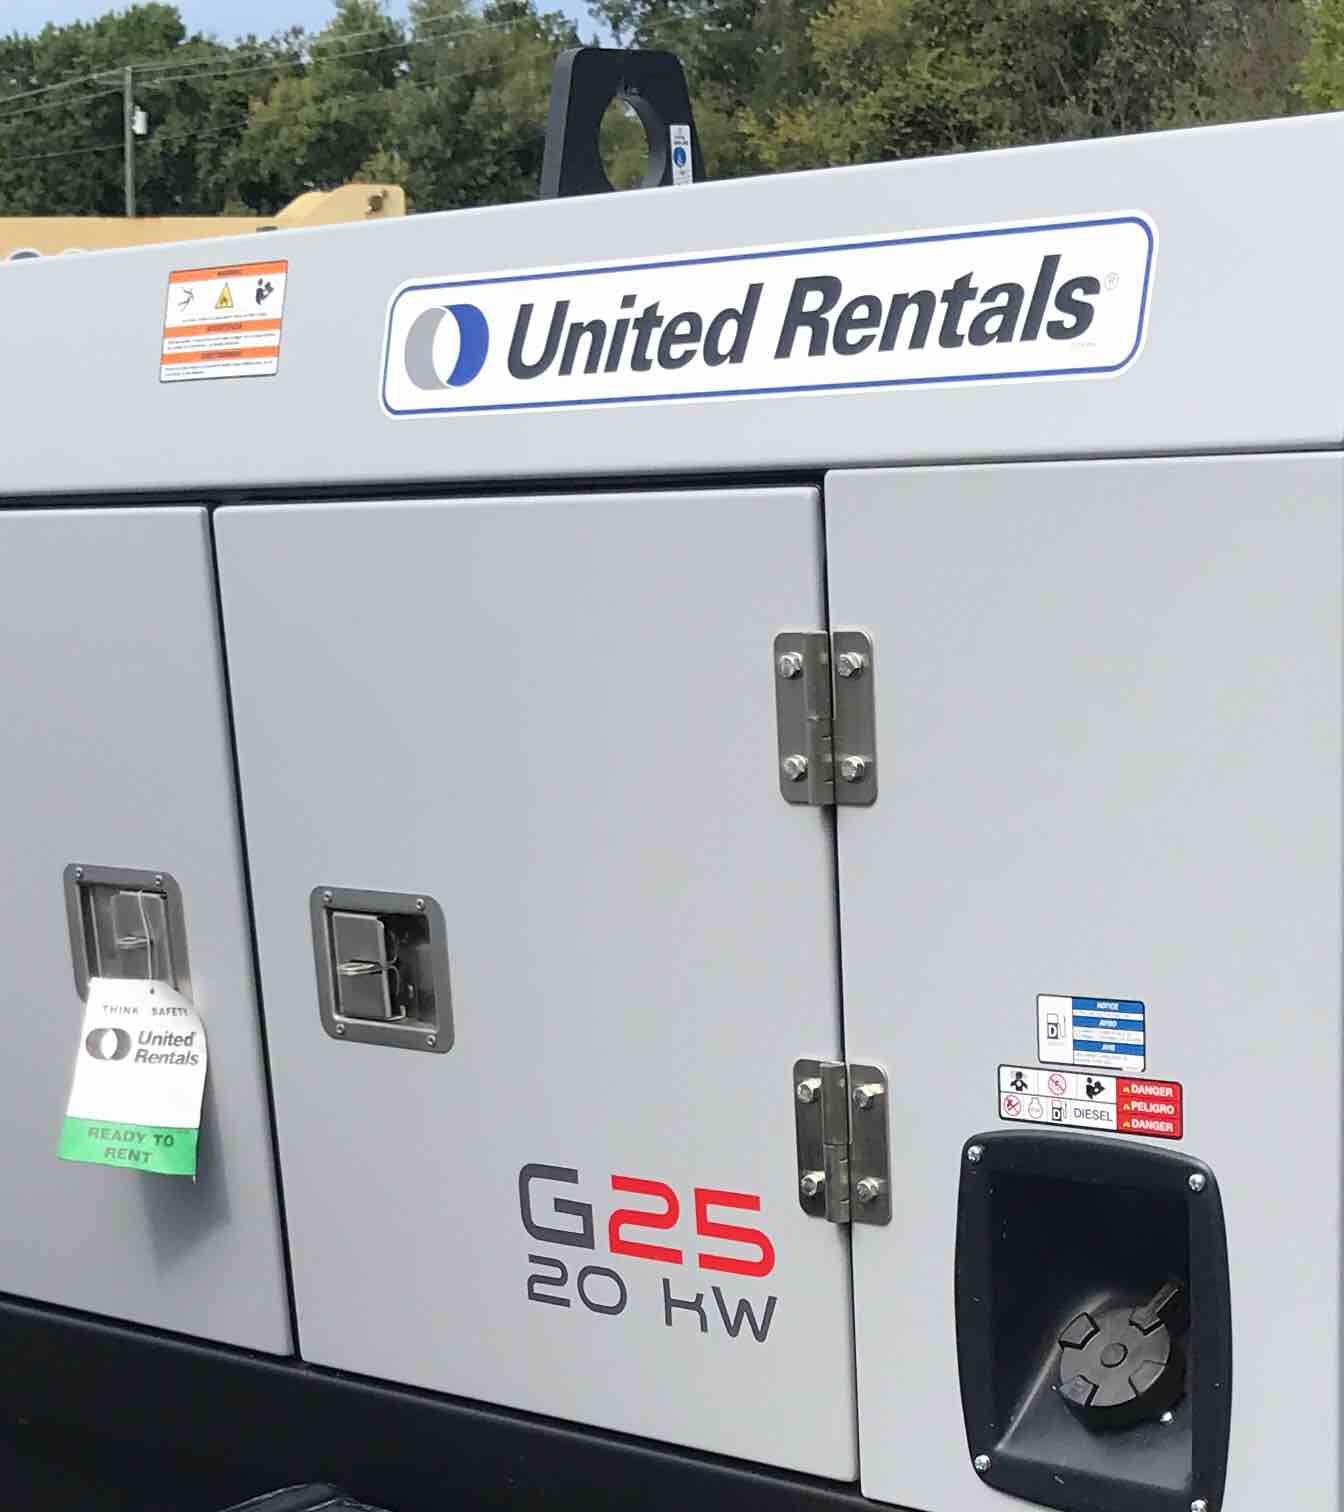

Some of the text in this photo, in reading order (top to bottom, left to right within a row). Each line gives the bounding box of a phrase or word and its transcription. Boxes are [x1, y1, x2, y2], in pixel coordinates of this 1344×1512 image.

[506, 253, 1103, 380] United Rentals
[102, 1004, 189, 1017] THINK SAFETY
[137, 1029, 194, 1047] United
[134, 1048, 199, 1066] Rentals
[1130, 1084, 1174, 1097] DANGER
[1073, 1107, 1113, 1122] DIESEL
[1131, 1101, 1175, 1115] PELIGRO
[1131, 1118, 1174, 1132] DANGER
[88, 1127, 174, 1147] READY TO
[104, 1147, 152, 1164] RENT
[518, 1162, 776, 1278] G25
[526, 1253, 628, 1315] 20
